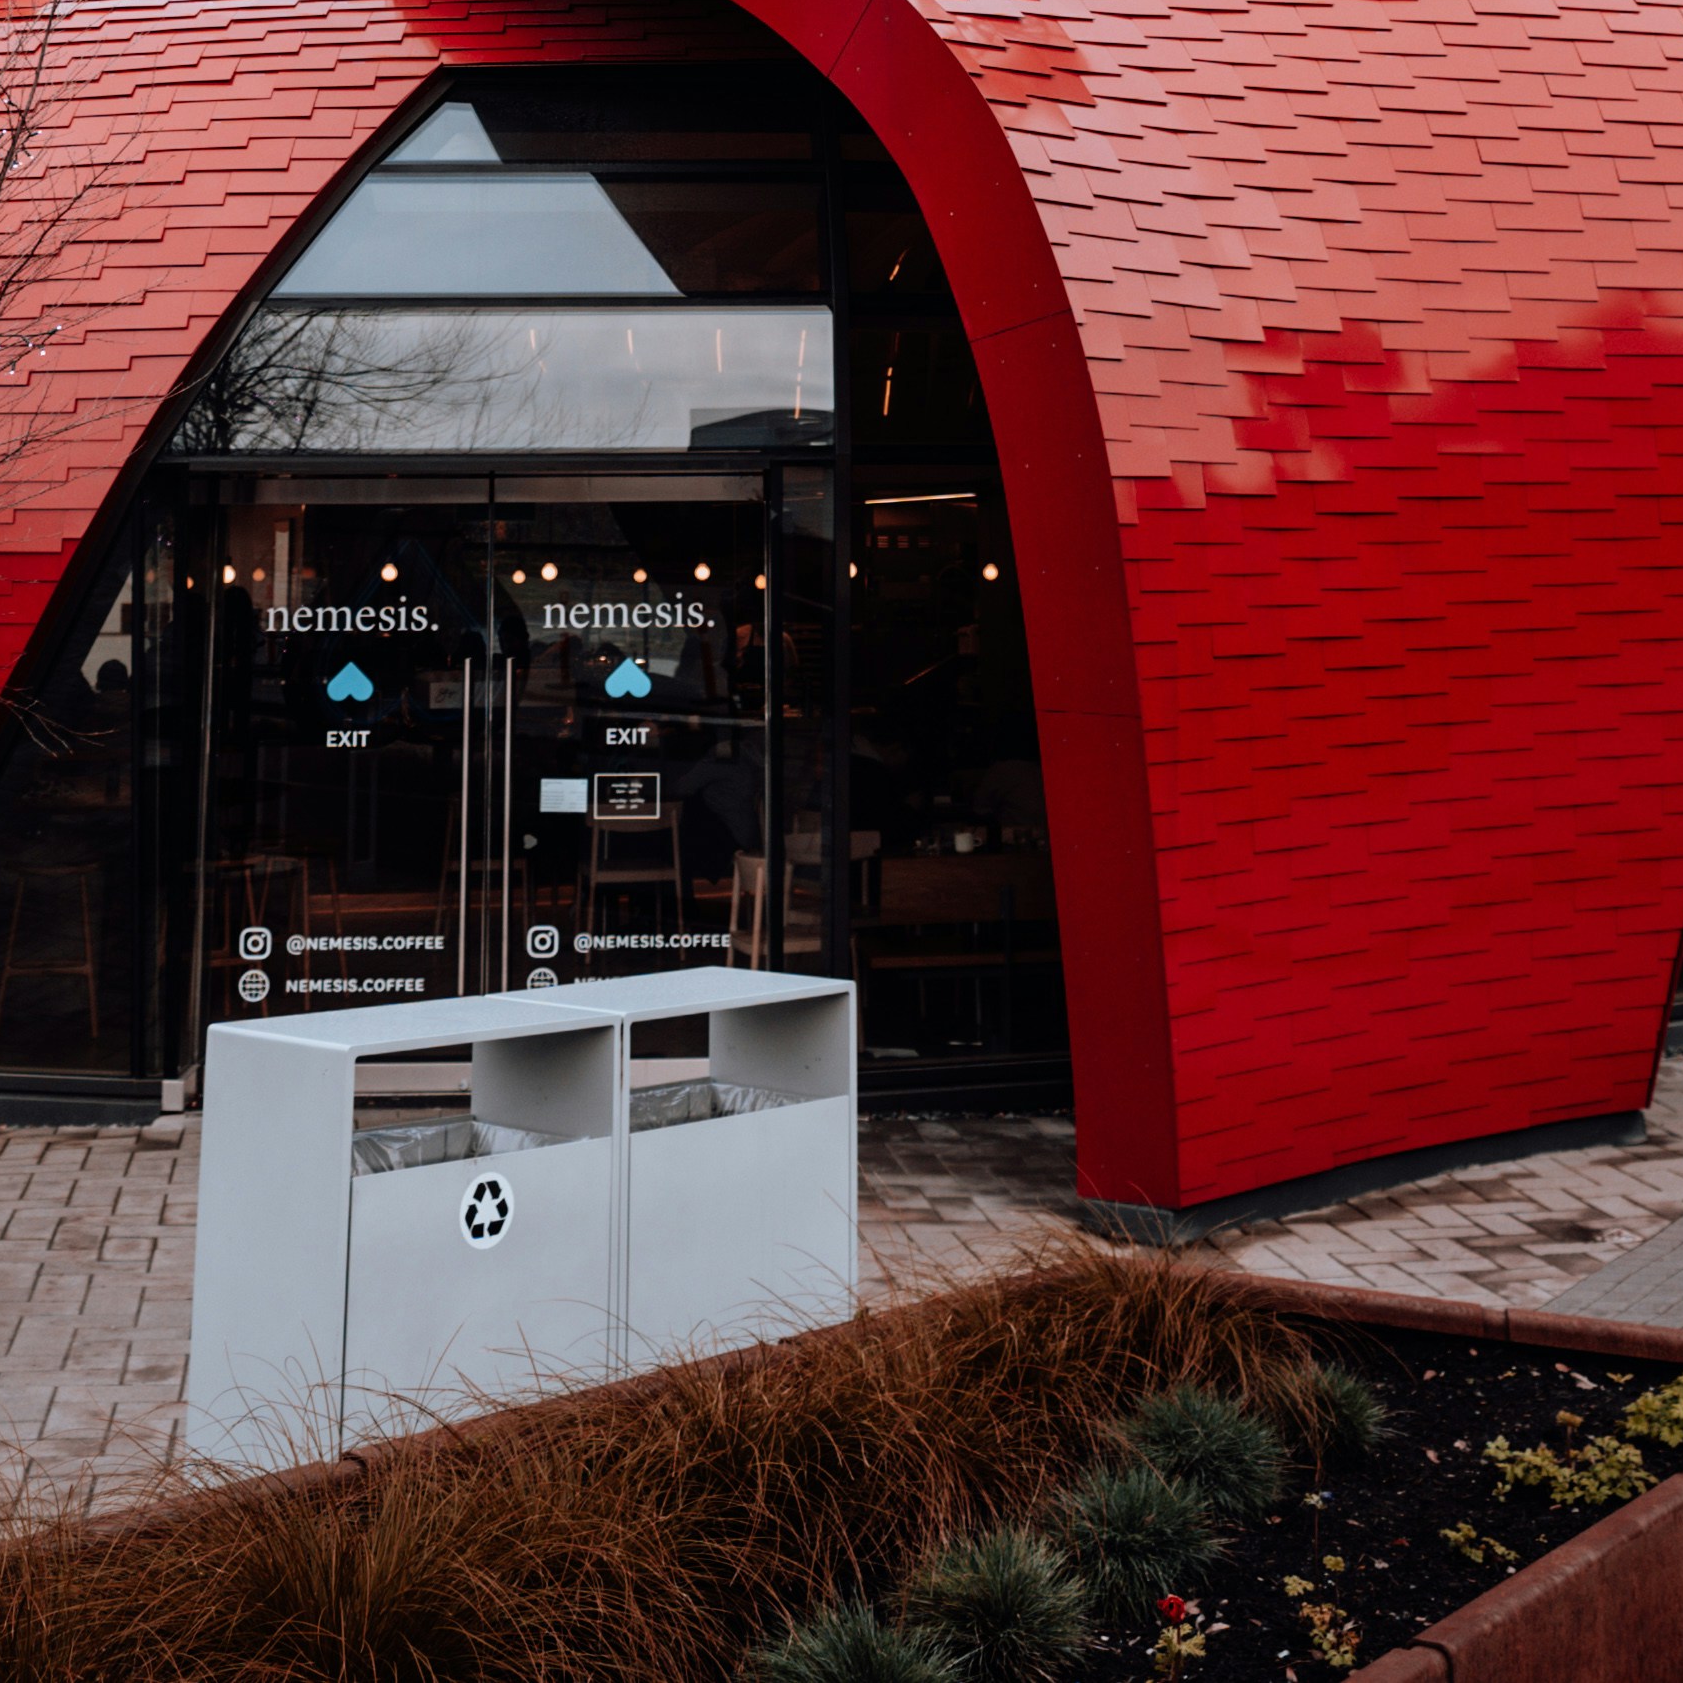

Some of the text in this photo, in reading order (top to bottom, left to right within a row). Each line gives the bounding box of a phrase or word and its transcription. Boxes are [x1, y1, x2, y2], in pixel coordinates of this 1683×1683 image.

[265, 595, 439, 632] nemesis.
[542, 592, 715, 629] nemesis.
[326, 730, 371, 748] EXIT
[606, 727, 650, 745] EXIT
[286, 934, 445, 955] @NEMESIS.COFFEE
[574, 932, 731, 953] @NEMESIS.COFFEE
[285, 977, 425, 993] NEMESIS.COFFEE
